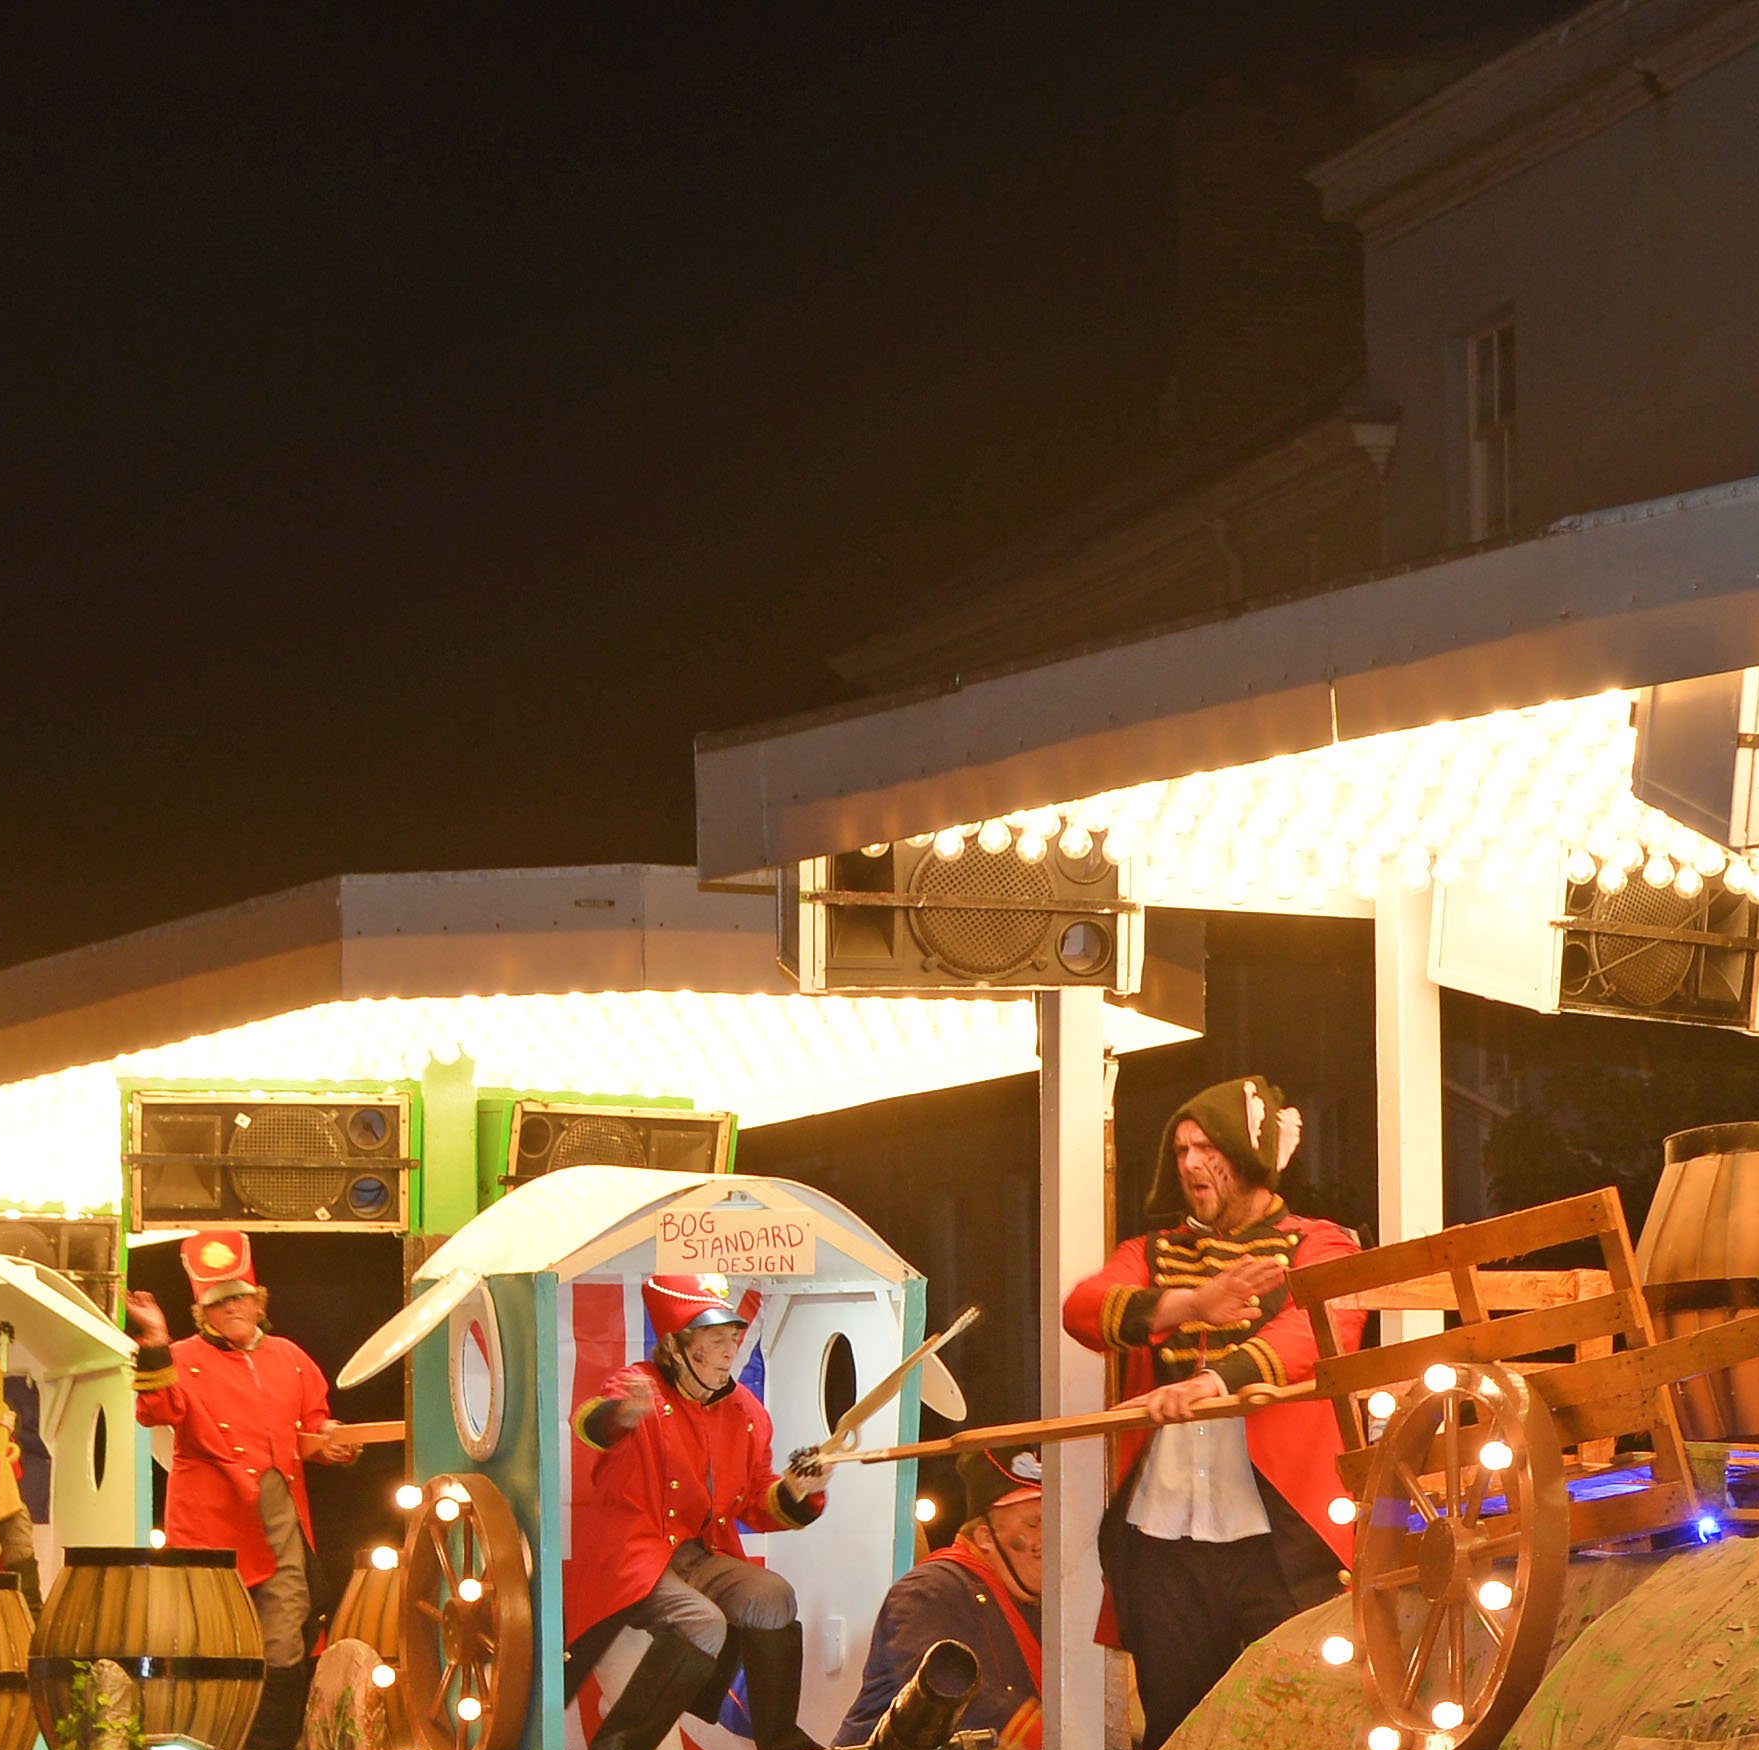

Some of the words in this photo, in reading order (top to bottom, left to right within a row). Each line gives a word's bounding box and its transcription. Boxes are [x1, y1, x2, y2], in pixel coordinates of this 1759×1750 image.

[661, 1211, 715, 1243] BOG
[681, 1223, 804, 1260] STANDARD
[716, 1254, 795, 1273] DESIGN
